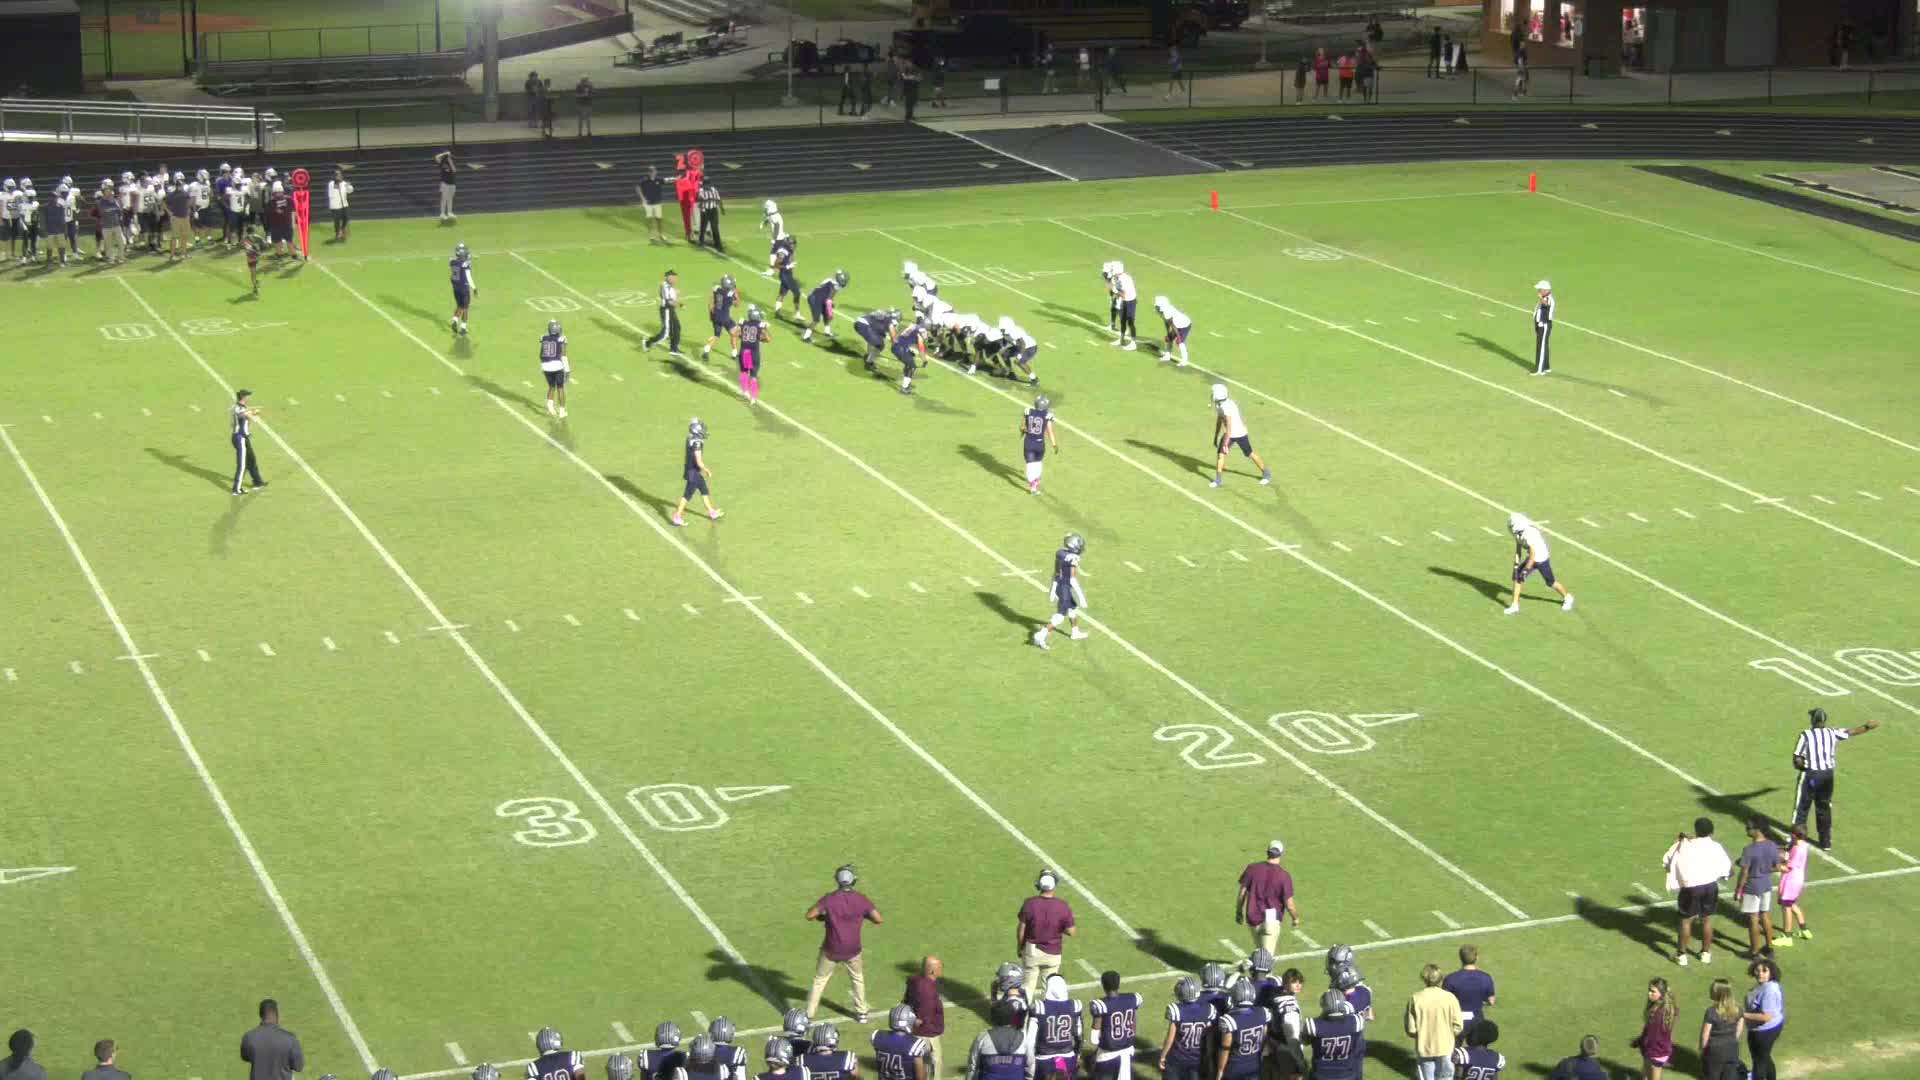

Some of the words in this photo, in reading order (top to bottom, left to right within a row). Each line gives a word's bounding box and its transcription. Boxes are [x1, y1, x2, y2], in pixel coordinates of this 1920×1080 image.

[1046, 1014, 1071, 1043] 12
[1110, 1009, 1135, 1040] 84
[1239, 1024, 1264, 1055] 57
[1321, 1035, 1351, 1061] 77
[878, 1052, 906, 1079] 74
